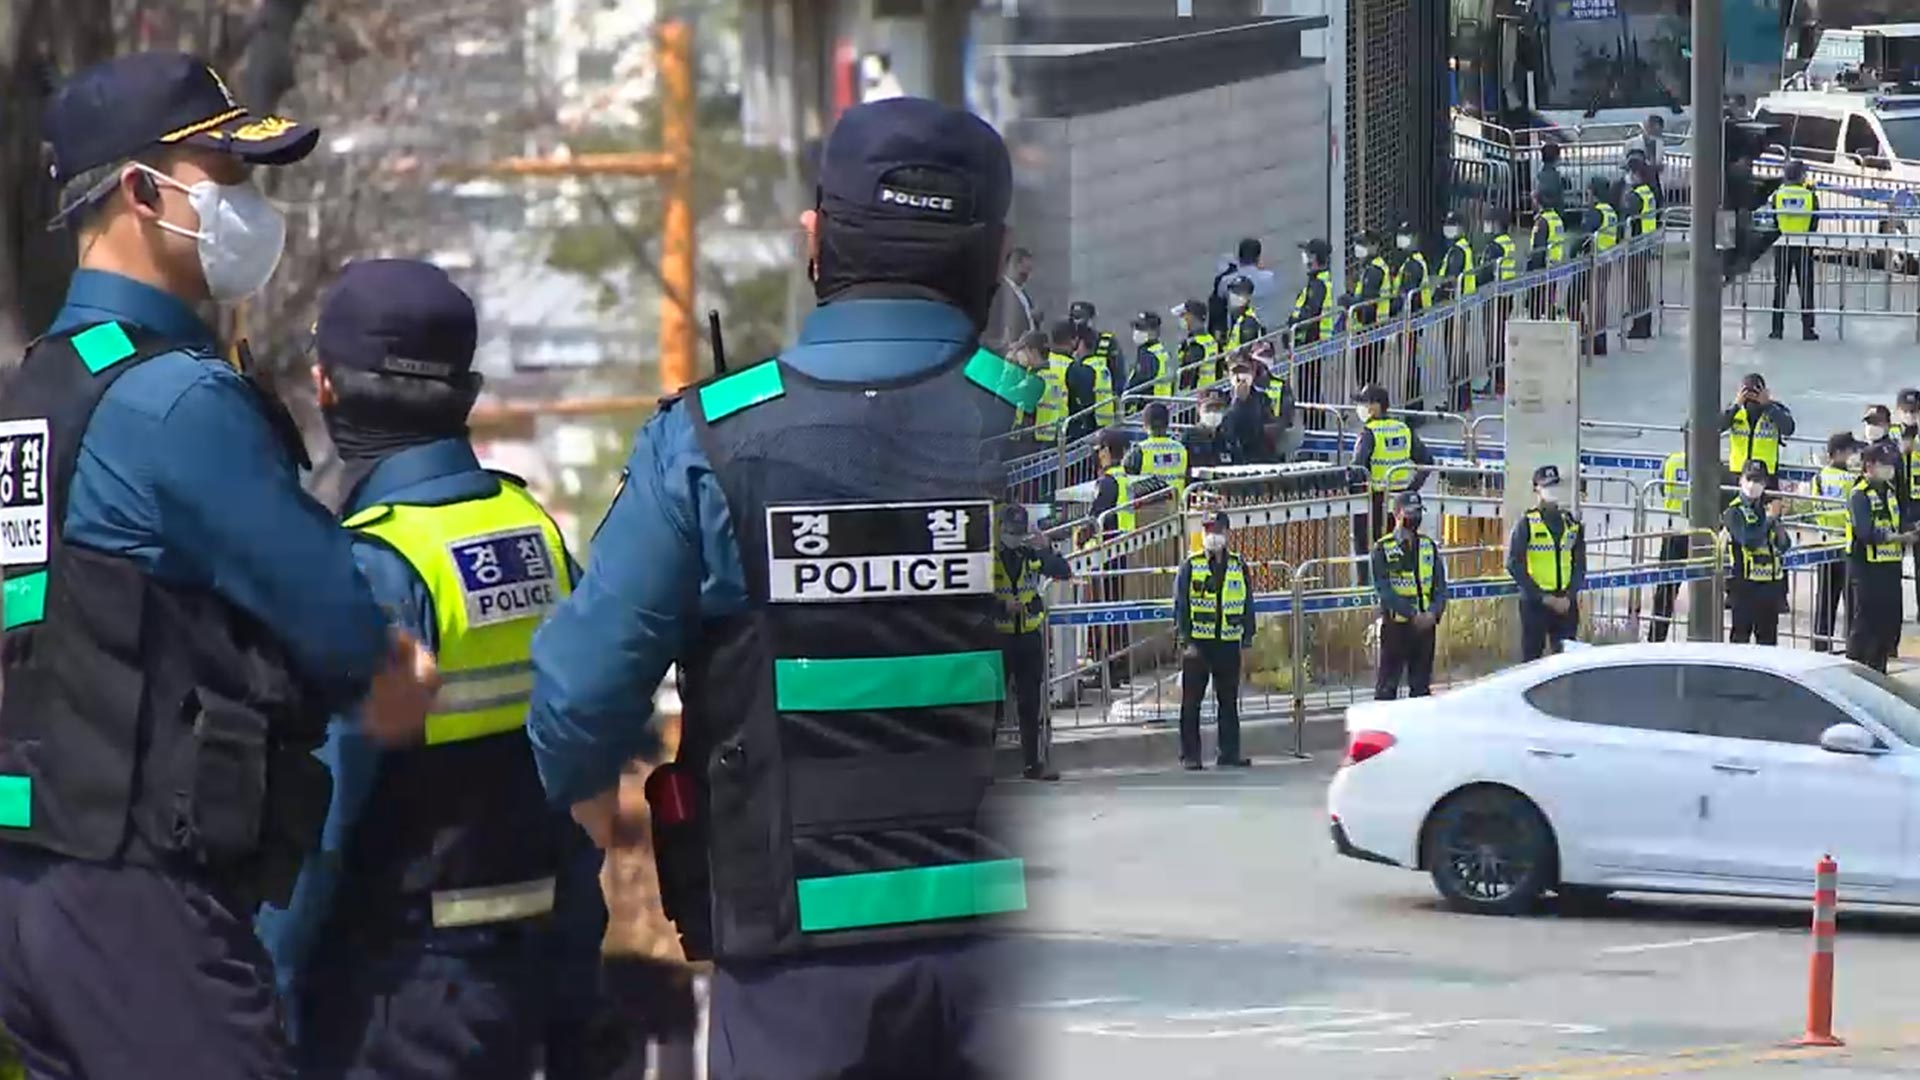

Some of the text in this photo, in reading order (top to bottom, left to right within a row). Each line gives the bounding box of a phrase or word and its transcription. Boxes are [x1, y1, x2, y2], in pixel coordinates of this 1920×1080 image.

[882, 189, 953, 210] POLICE
[1, 519, 42, 547] POLICE
[792, 509, 970, 555] 경찰
[463, 536, 547, 584] 경찰
[794, 558, 970, 594] POLICE
[479, 585, 553, 615] POLICE
[1087, 608, 1162, 622] POLIC
